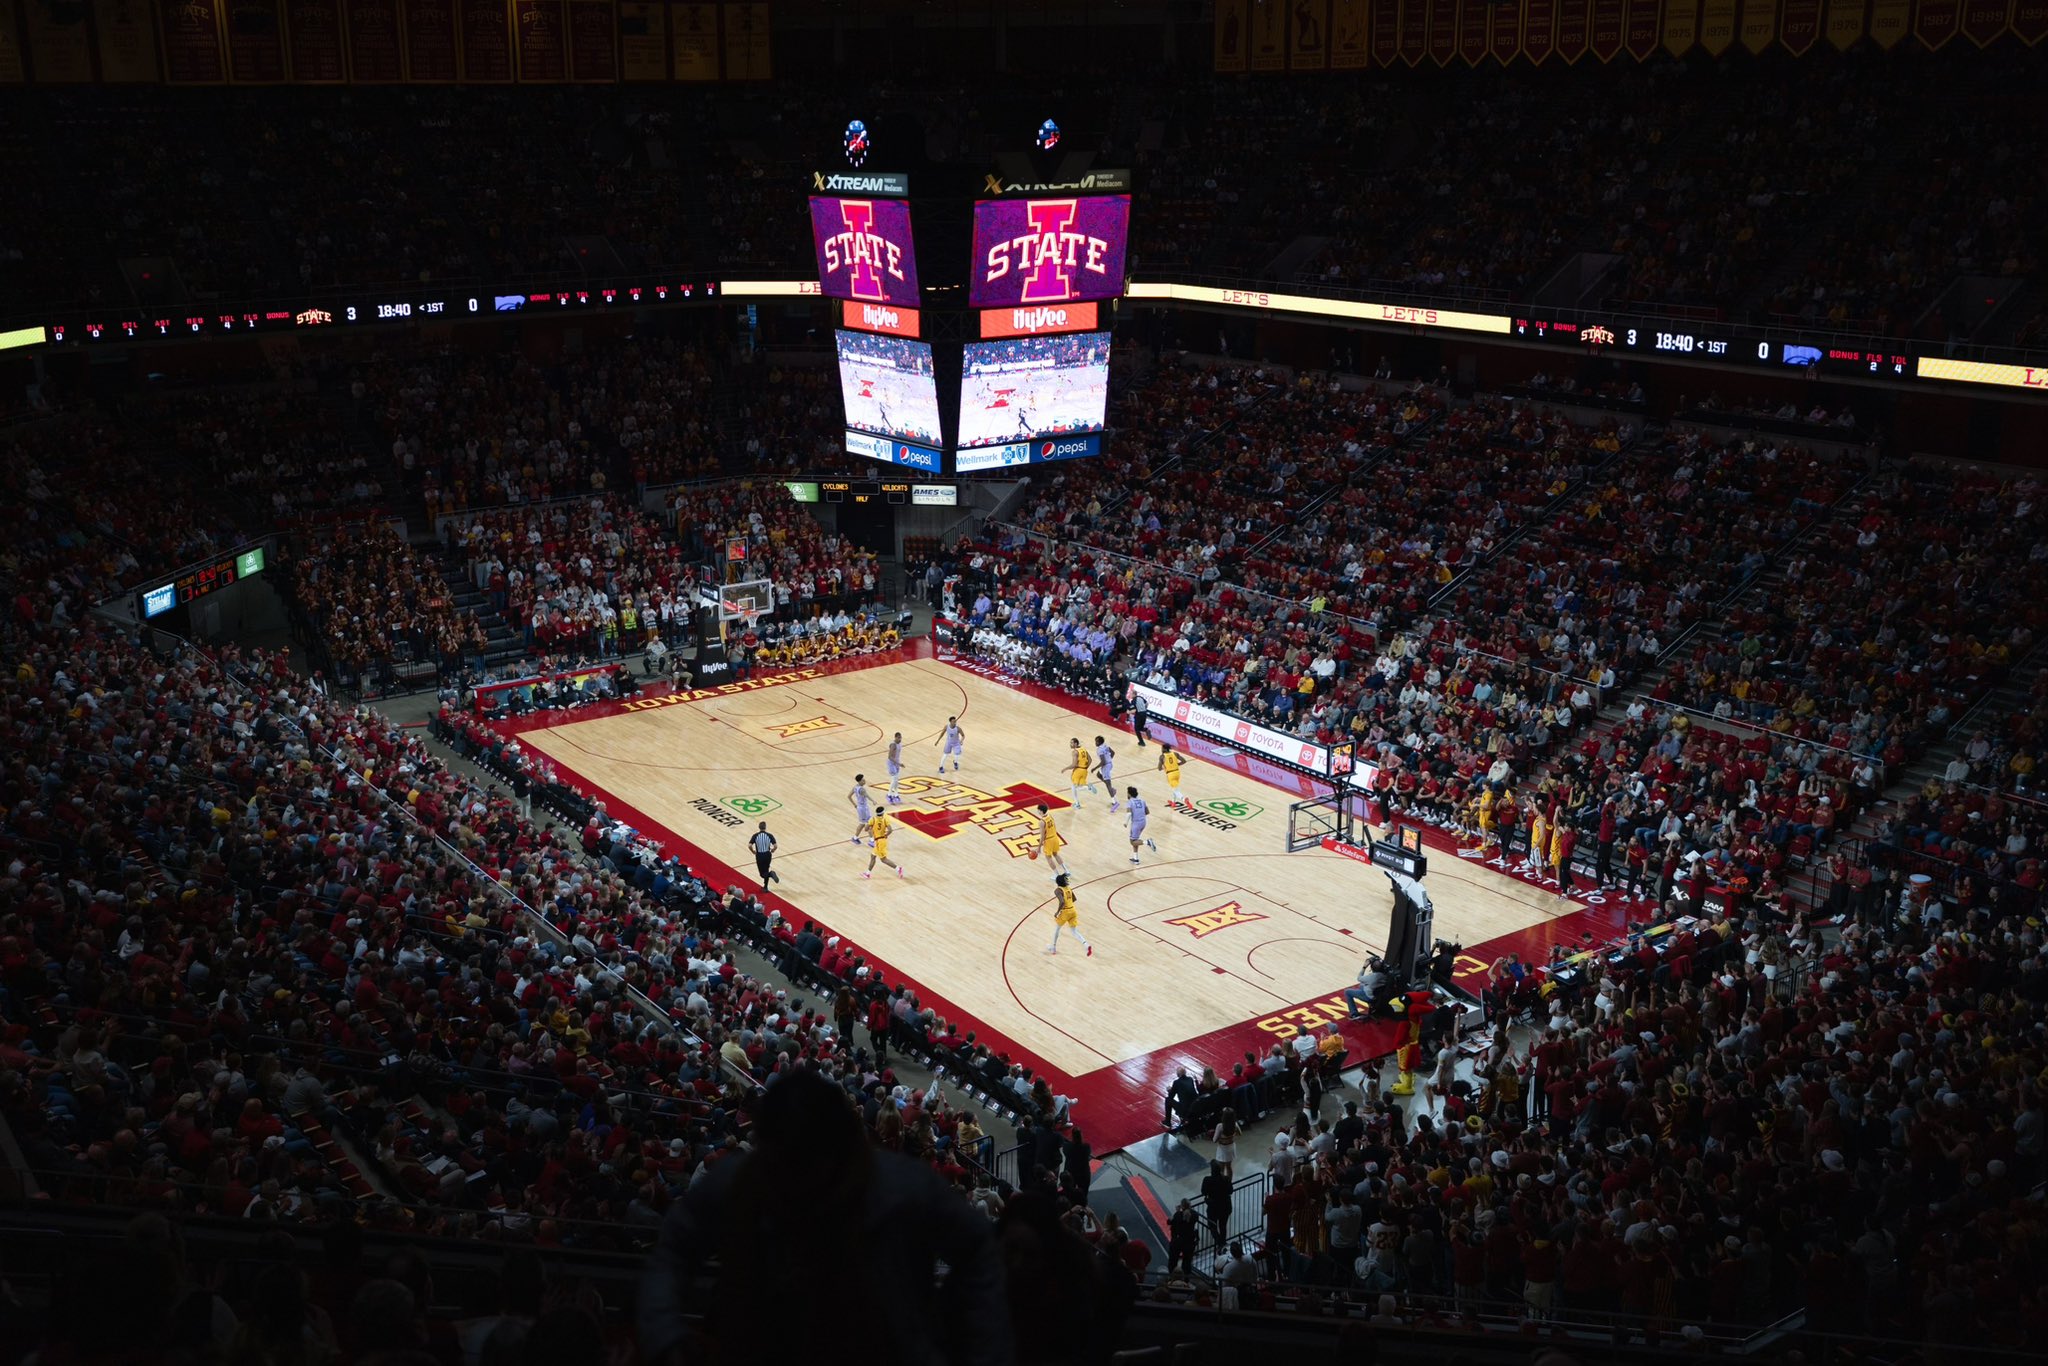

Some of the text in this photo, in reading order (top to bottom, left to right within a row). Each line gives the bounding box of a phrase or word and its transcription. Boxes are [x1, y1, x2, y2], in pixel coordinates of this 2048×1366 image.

[1923, 14, 1953, 26] 1987
[1745, 24, 1770, 35] 1977
[1787, 23, 1815, 33] 1977
[827, 174, 883, 191] XTREAM
[824, 231, 905, 281] STATE
[986, 232, 1108, 282] STATE
[468, 298, 478, 312] 0
[1222, 290, 1269, 306] LET'S
[296, 309, 332, 325] STATE
[346, 307, 356, 320] 3
[377, 302, 444, 318] 18:40 1ST
[1382, 306, 1438, 323] LET'S
[127, 328, 134, 336] 1
[192, 323, 199, 331] 0
[224, 321, 231, 329] 4
[1518, 326, 1524, 334] 4
[1538, 328, 1543, 336] 1
[56, 332, 63, 340] 0
[92, 329, 100, 338] 0
[1581, 327, 1614, 344] STATE
[1627, 329, 1637, 345] 3
[1655, 332, 1727, 354] 18:40 1ST
[1758, 342, 1769, 359] 0
[1829, 350, 1859, 360] BONUS
[1870, 361, 1877, 371] 2
[1894, 364, 1902, 374] 4
[1057, 440, 1087, 457] pepsi
[910, 452, 932, 466] pepsi
[956, 452, 998, 466] Wellmark
[620, 669, 824, 712] IOWA STATE
[1191, 711, 1220, 728] TOYOTA
[1252, 732, 1284, 751] TOYOTA
[687, 798, 744, 827] PIONEER
[868, 775, 1068, 858] STATE
[1164, 801, 1237, 831] PIONEER
[877, 823, 882, 831] 3
